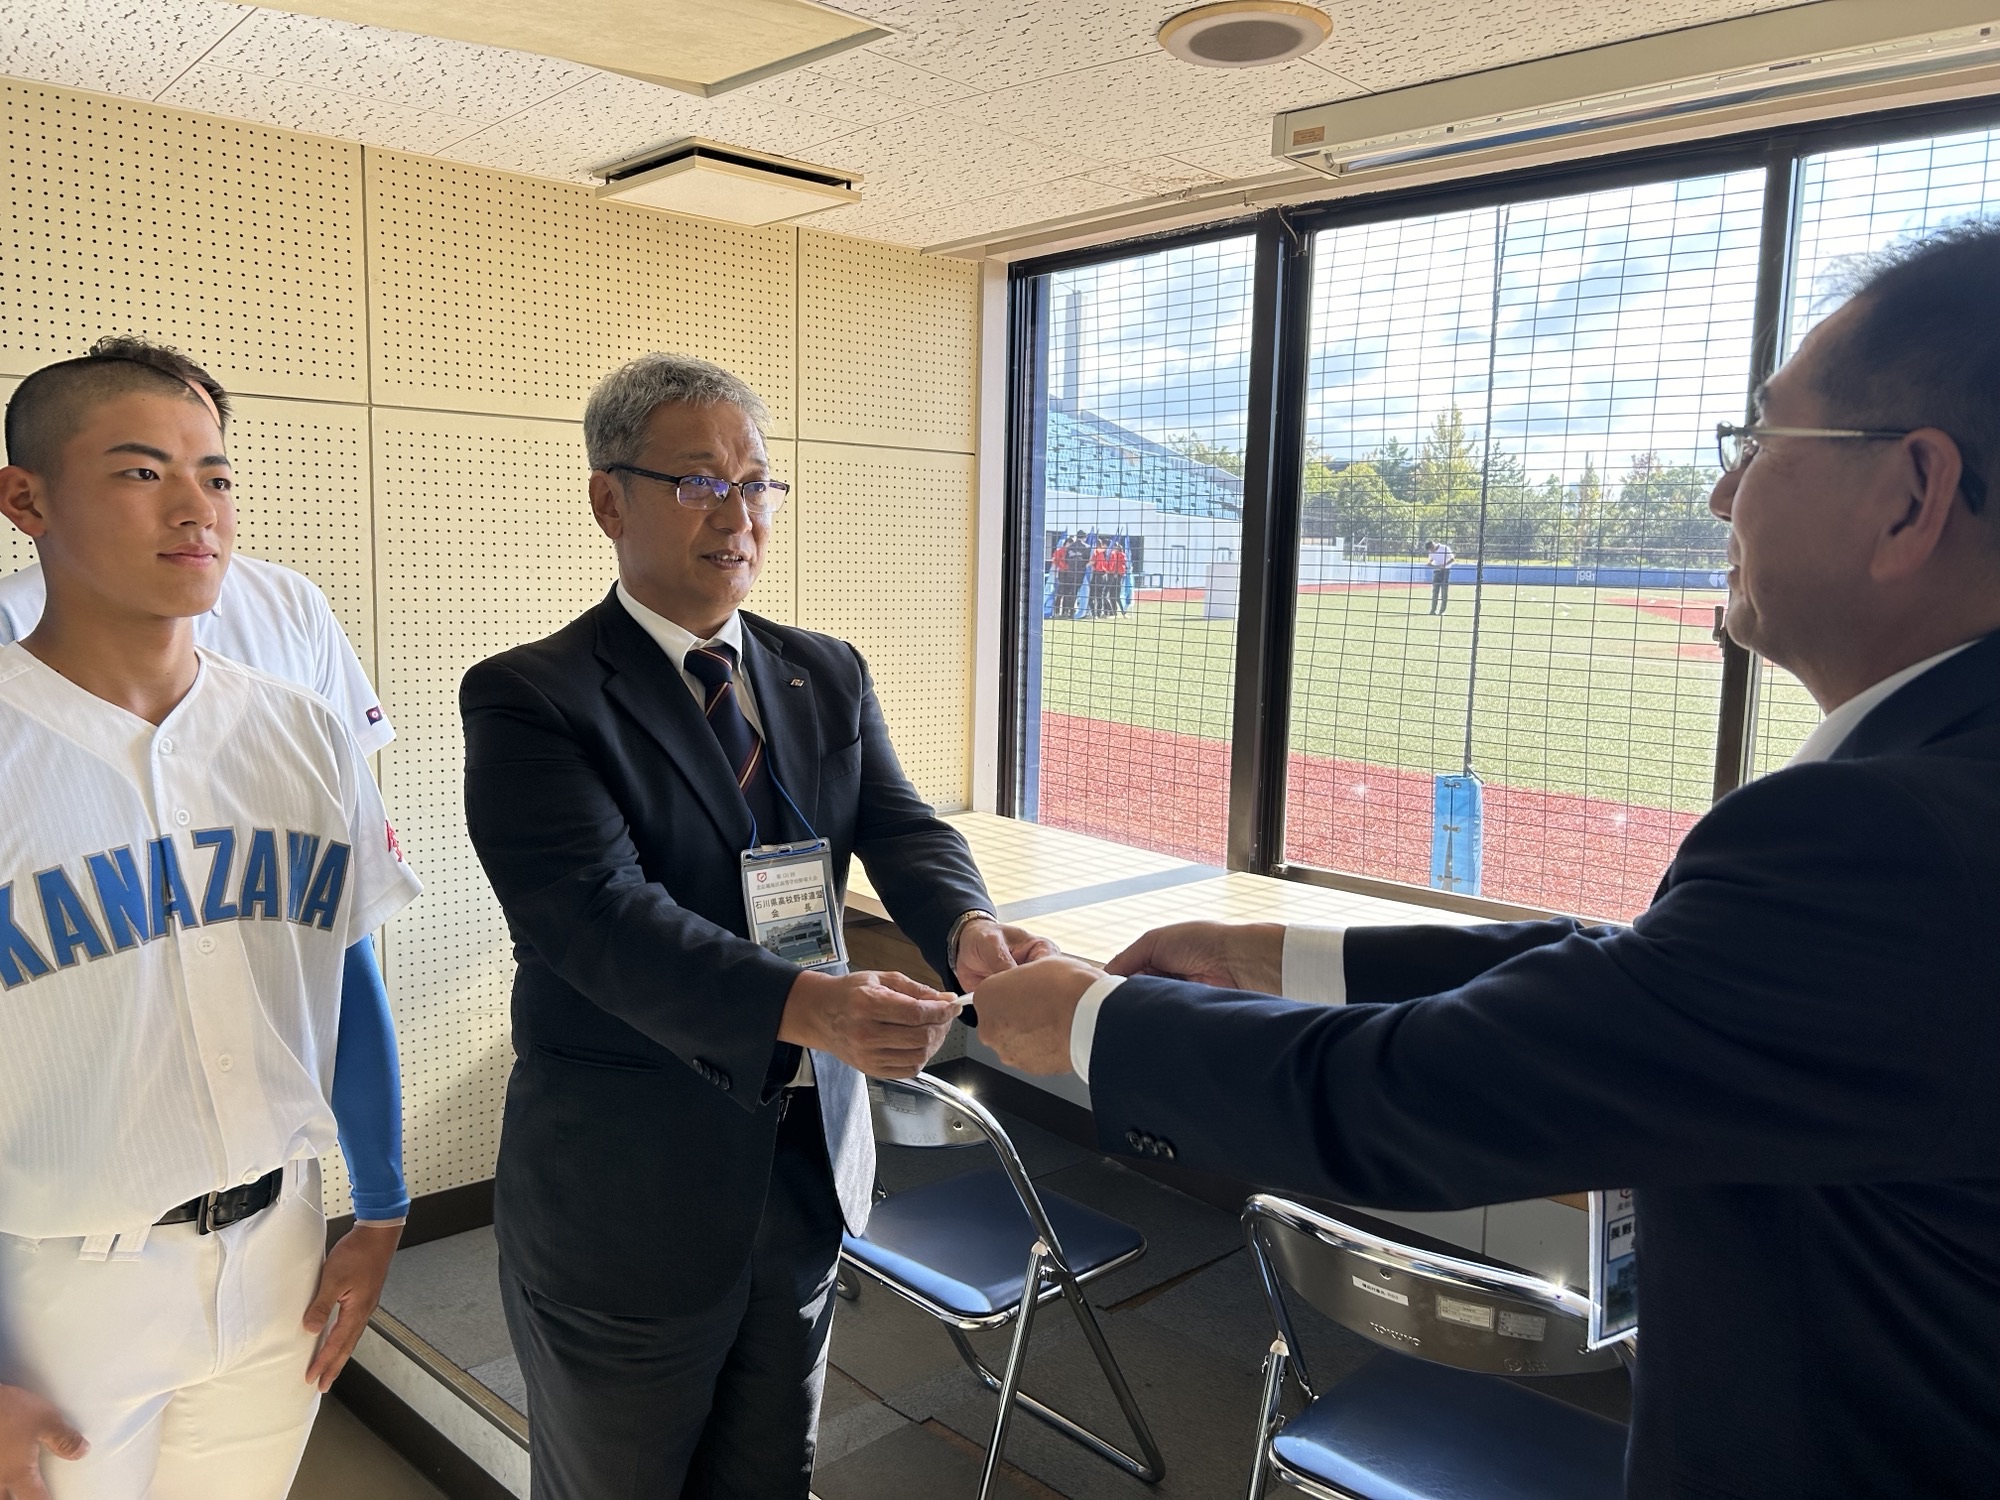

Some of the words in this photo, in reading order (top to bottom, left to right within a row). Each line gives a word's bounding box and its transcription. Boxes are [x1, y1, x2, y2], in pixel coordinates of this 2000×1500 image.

[0, 826, 352, 991] KANAZAWA
[755, 889, 823, 909] 石川県高校野球連盟
